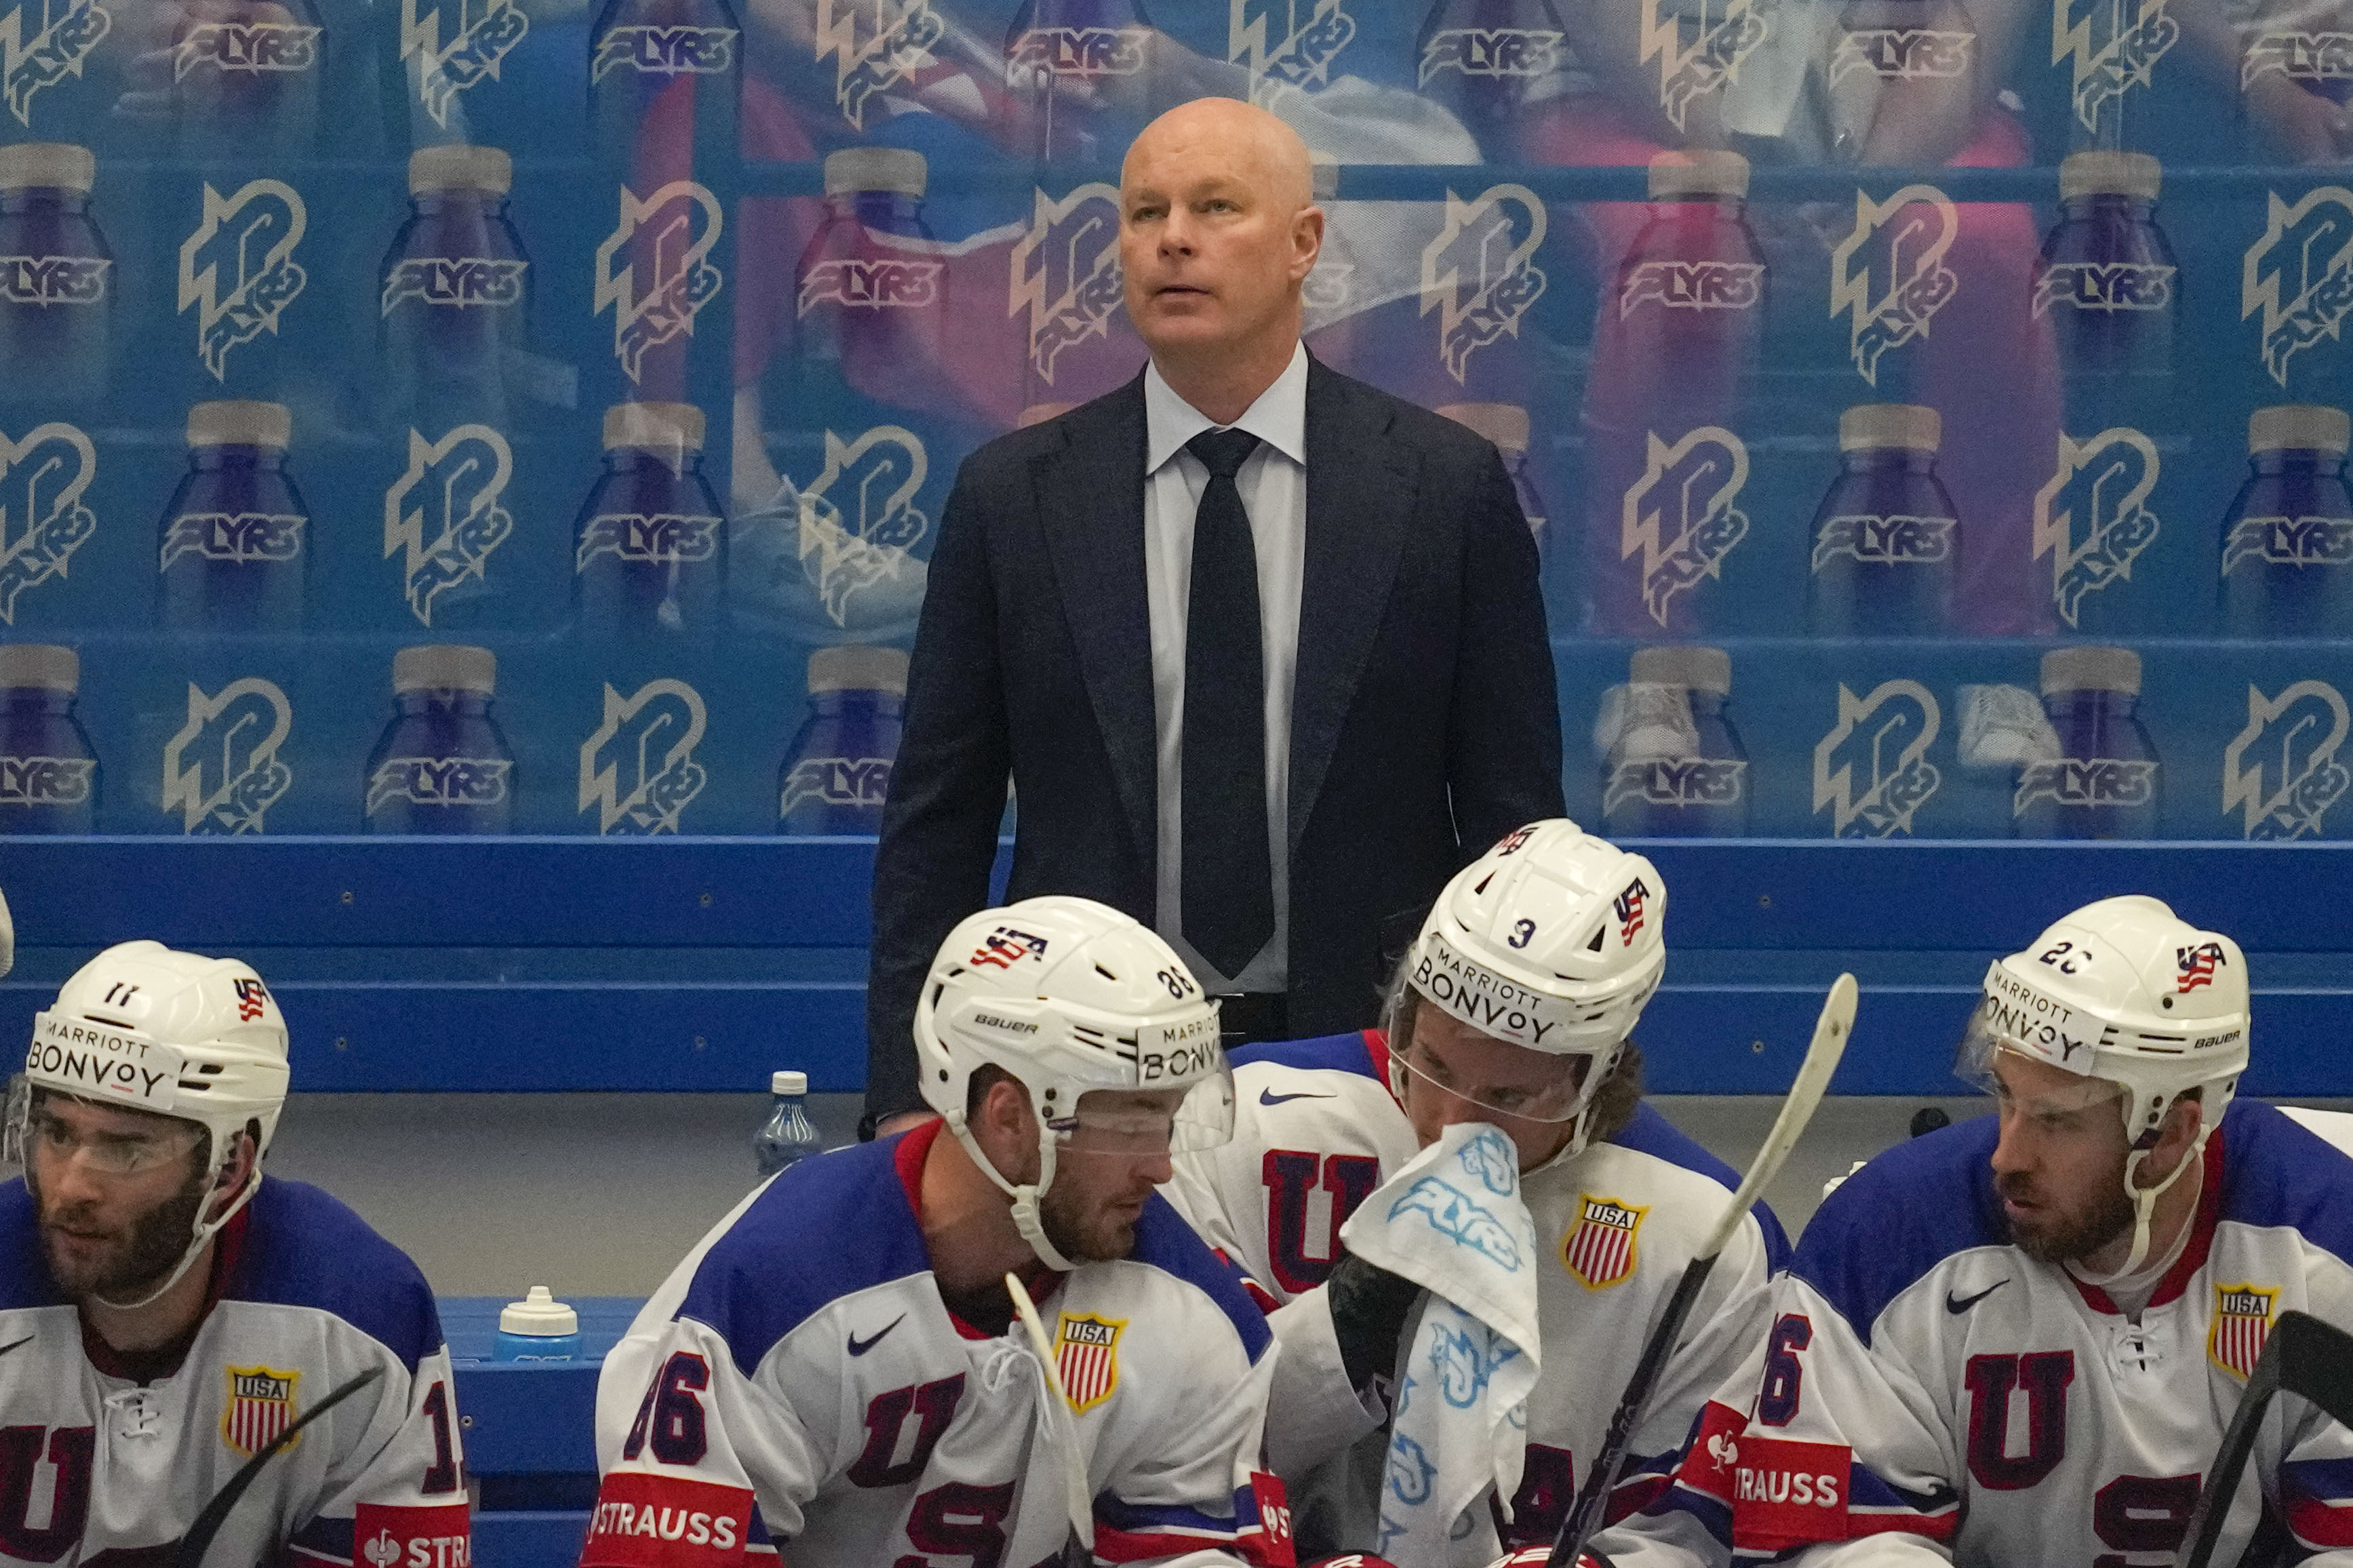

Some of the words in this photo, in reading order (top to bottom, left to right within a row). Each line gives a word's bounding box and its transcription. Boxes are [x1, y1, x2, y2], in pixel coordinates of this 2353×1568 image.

[2240, 31, 2353, 90] PLYR
[0, 256, 113, 310] LYRS
[780, 758, 896, 817] PLYR
[1508, 919, 1535, 948] 3
[1416, 956, 1554, 1043] BONVOY
[1438, 948, 1542, 1010] MARRIOTT
[1994, 971, 2073, 1024] MARRIOTT
[47, 1020, 150, 1058] MARRIOTT
[1985, 988, 2083, 1062] ONVOY
[28, 1041, 165, 1097] BONVOY
[1591, 1205, 1628, 1228] USA
[2227, 1295, 2263, 1314] USA
[1071, 1323, 1107, 1344] USA
[243, 1377, 283, 1398] USA
[1747, 1312, 1814, 1427] 6
[598, 1502, 738, 1550] STRAUSS
